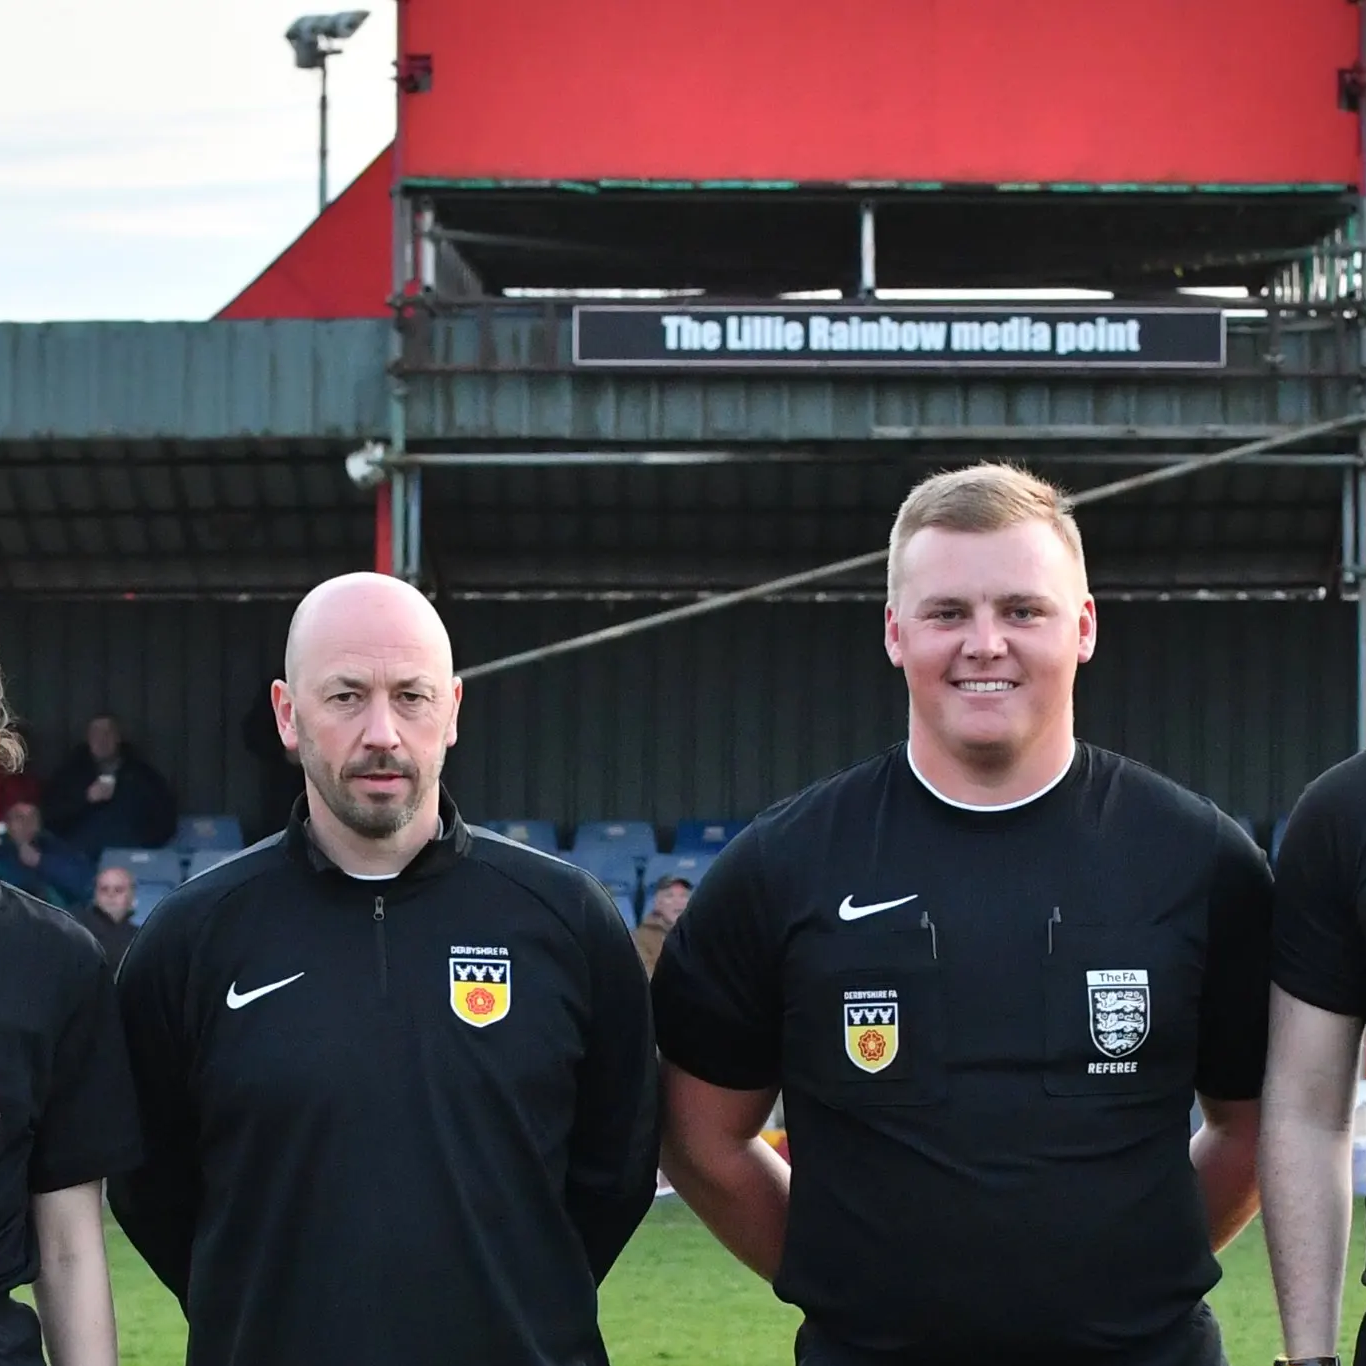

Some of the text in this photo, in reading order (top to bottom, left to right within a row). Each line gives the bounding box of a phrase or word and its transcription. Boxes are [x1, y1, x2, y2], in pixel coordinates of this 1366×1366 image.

[661, 315, 1141, 355] The Lillie Rainbow media point
[450, 945, 509, 957] DERBYSHIRE FA
[843, 989, 898, 1000] DERBYSHIRE FA
[1087, 1061, 1138, 1074] REFEREE
